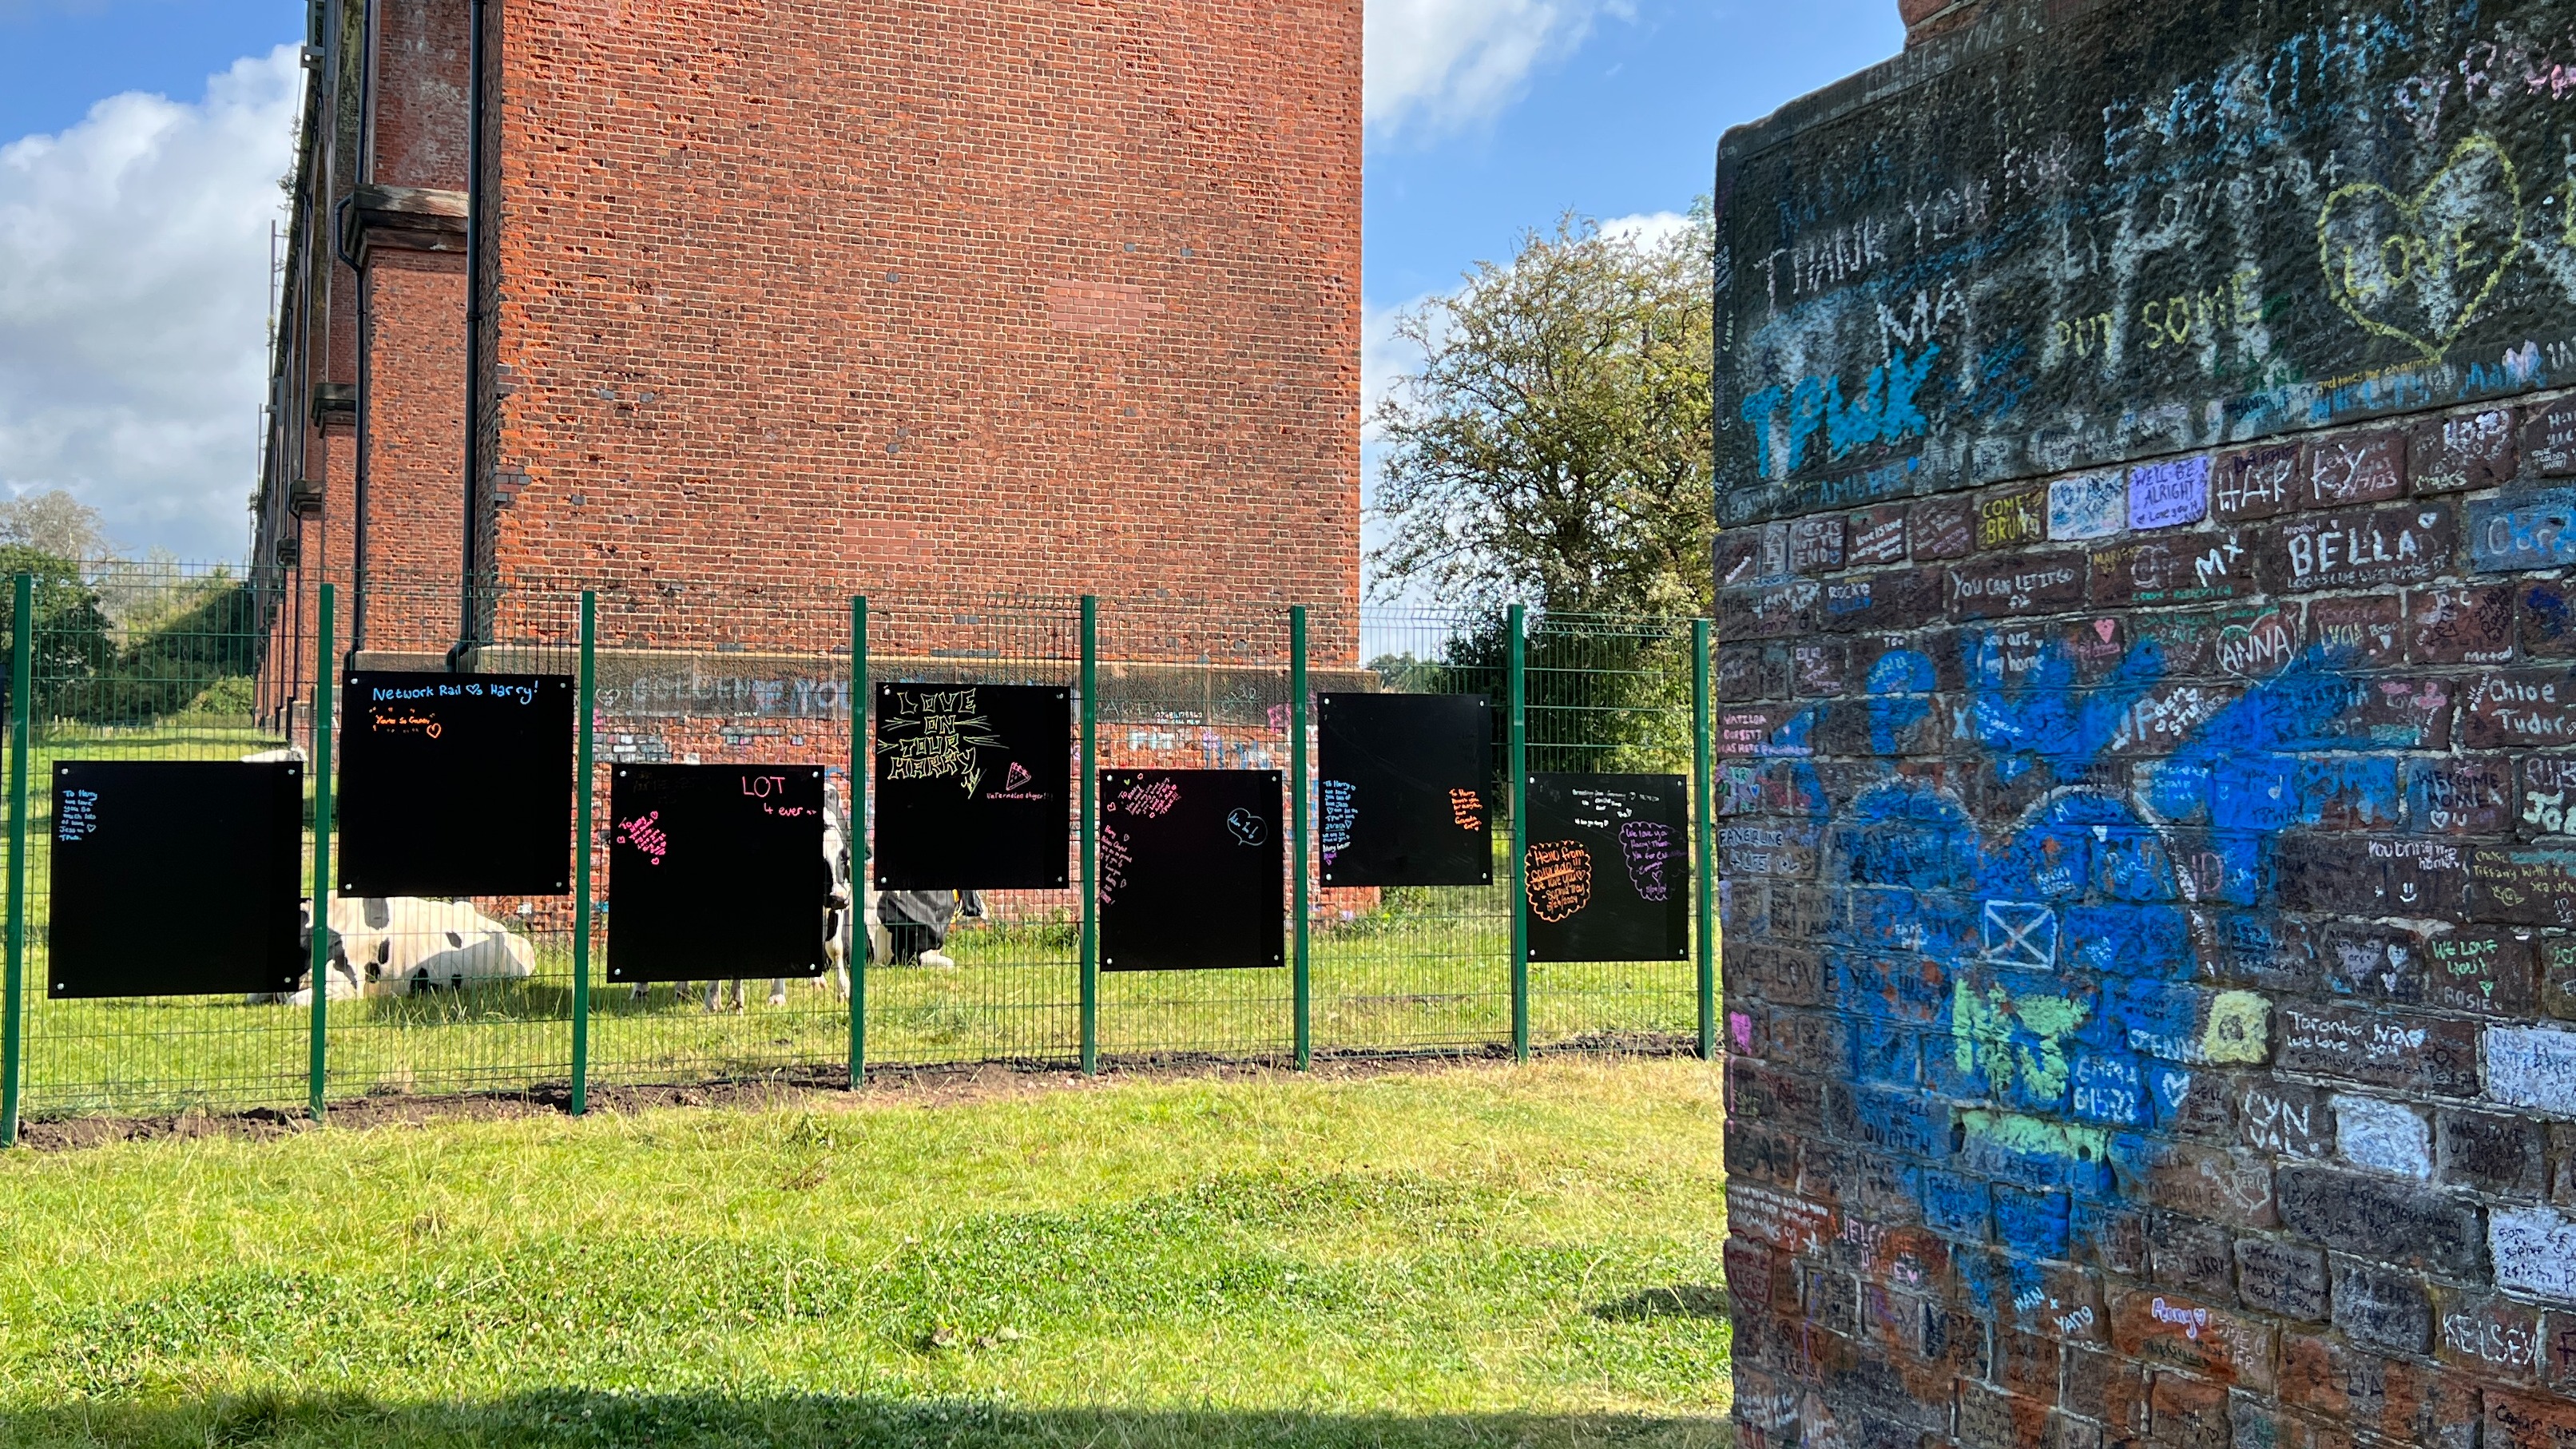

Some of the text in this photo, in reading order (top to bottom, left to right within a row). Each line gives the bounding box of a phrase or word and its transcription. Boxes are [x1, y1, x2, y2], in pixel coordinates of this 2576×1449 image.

[1905, 178, 1991, 250] YOU
[2054, 218, 2490, 362] PUT SOME LOVE
[2175, 463, 2196, 479] BE
[2144, 482, 2195, 506] ALRIGHT
[1825, 520, 1841, 537] IS
[1819, 534, 1844, 549] THE
[2288, 526, 2419, 578] BELLA
[1798, 547, 1828, 566] END
[1950, 570, 1983, 600] YOU
[1986, 577, 2012, 595] CAN
[2006, 631, 2030, 646] are
[2223, 625, 2296, 672] ANNA
[2007, 651, 2045, 673] home
[372, 680, 538, 705] Network Rail Harry!
[896, 687, 977, 714] LOVE
[2488, 678, 2557, 704] Chloe
[924, 714, 957, 734] ON
[2491, 708, 2566, 736] Tudor
[899, 732, 959, 758] TOUR
[887, 746, 976, 780] HARRY
[77, 788, 98, 801] Harry
[741, 776, 786, 797] LOT
[764, 803, 803, 817] 4 ever
[1638, 829, 1654, 838] love
[1534, 847, 1585, 867] Hello from
[2473, 864, 2518, 881] Tiffany
[2431, 939, 2499, 959] WE LOVE
[2443, 985, 2493, 1010] ROSIE
[2285, 1010, 2364, 1037] Toronto
[2314, 1034, 2348, 1052] love
[2151, 1296, 2197, 1340] Penny
[2442, 1312, 2537, 1365] KELSEY
